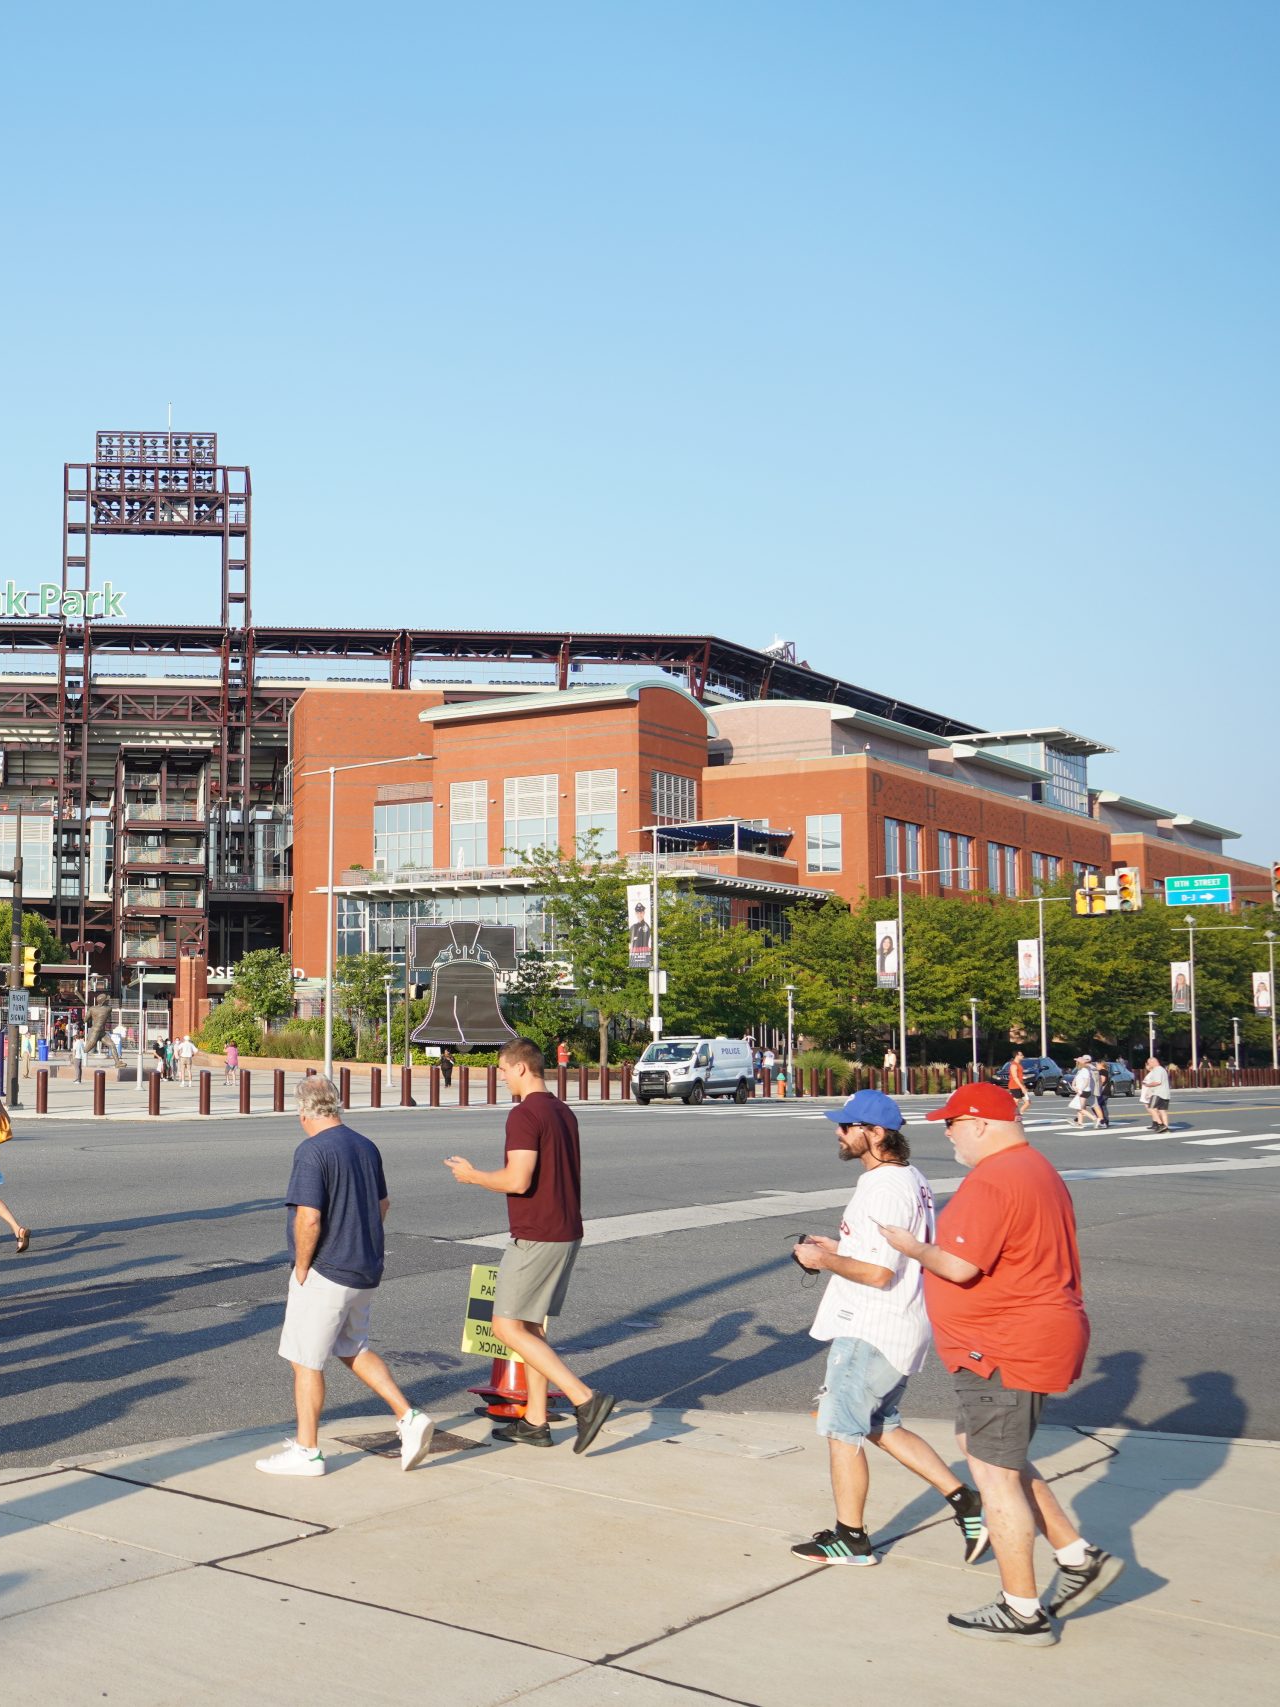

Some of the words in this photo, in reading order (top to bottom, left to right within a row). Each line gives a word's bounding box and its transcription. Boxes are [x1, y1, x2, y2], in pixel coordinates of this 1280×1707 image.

[39, 581, 127, 617] Park
[1193, 878, 1222, 887] STREET
[12, 1004, 25, 1012] TURN
[10, 1013, 26, 1021] SIGNAL
[721, 1047, 741, 1055] POLICE
